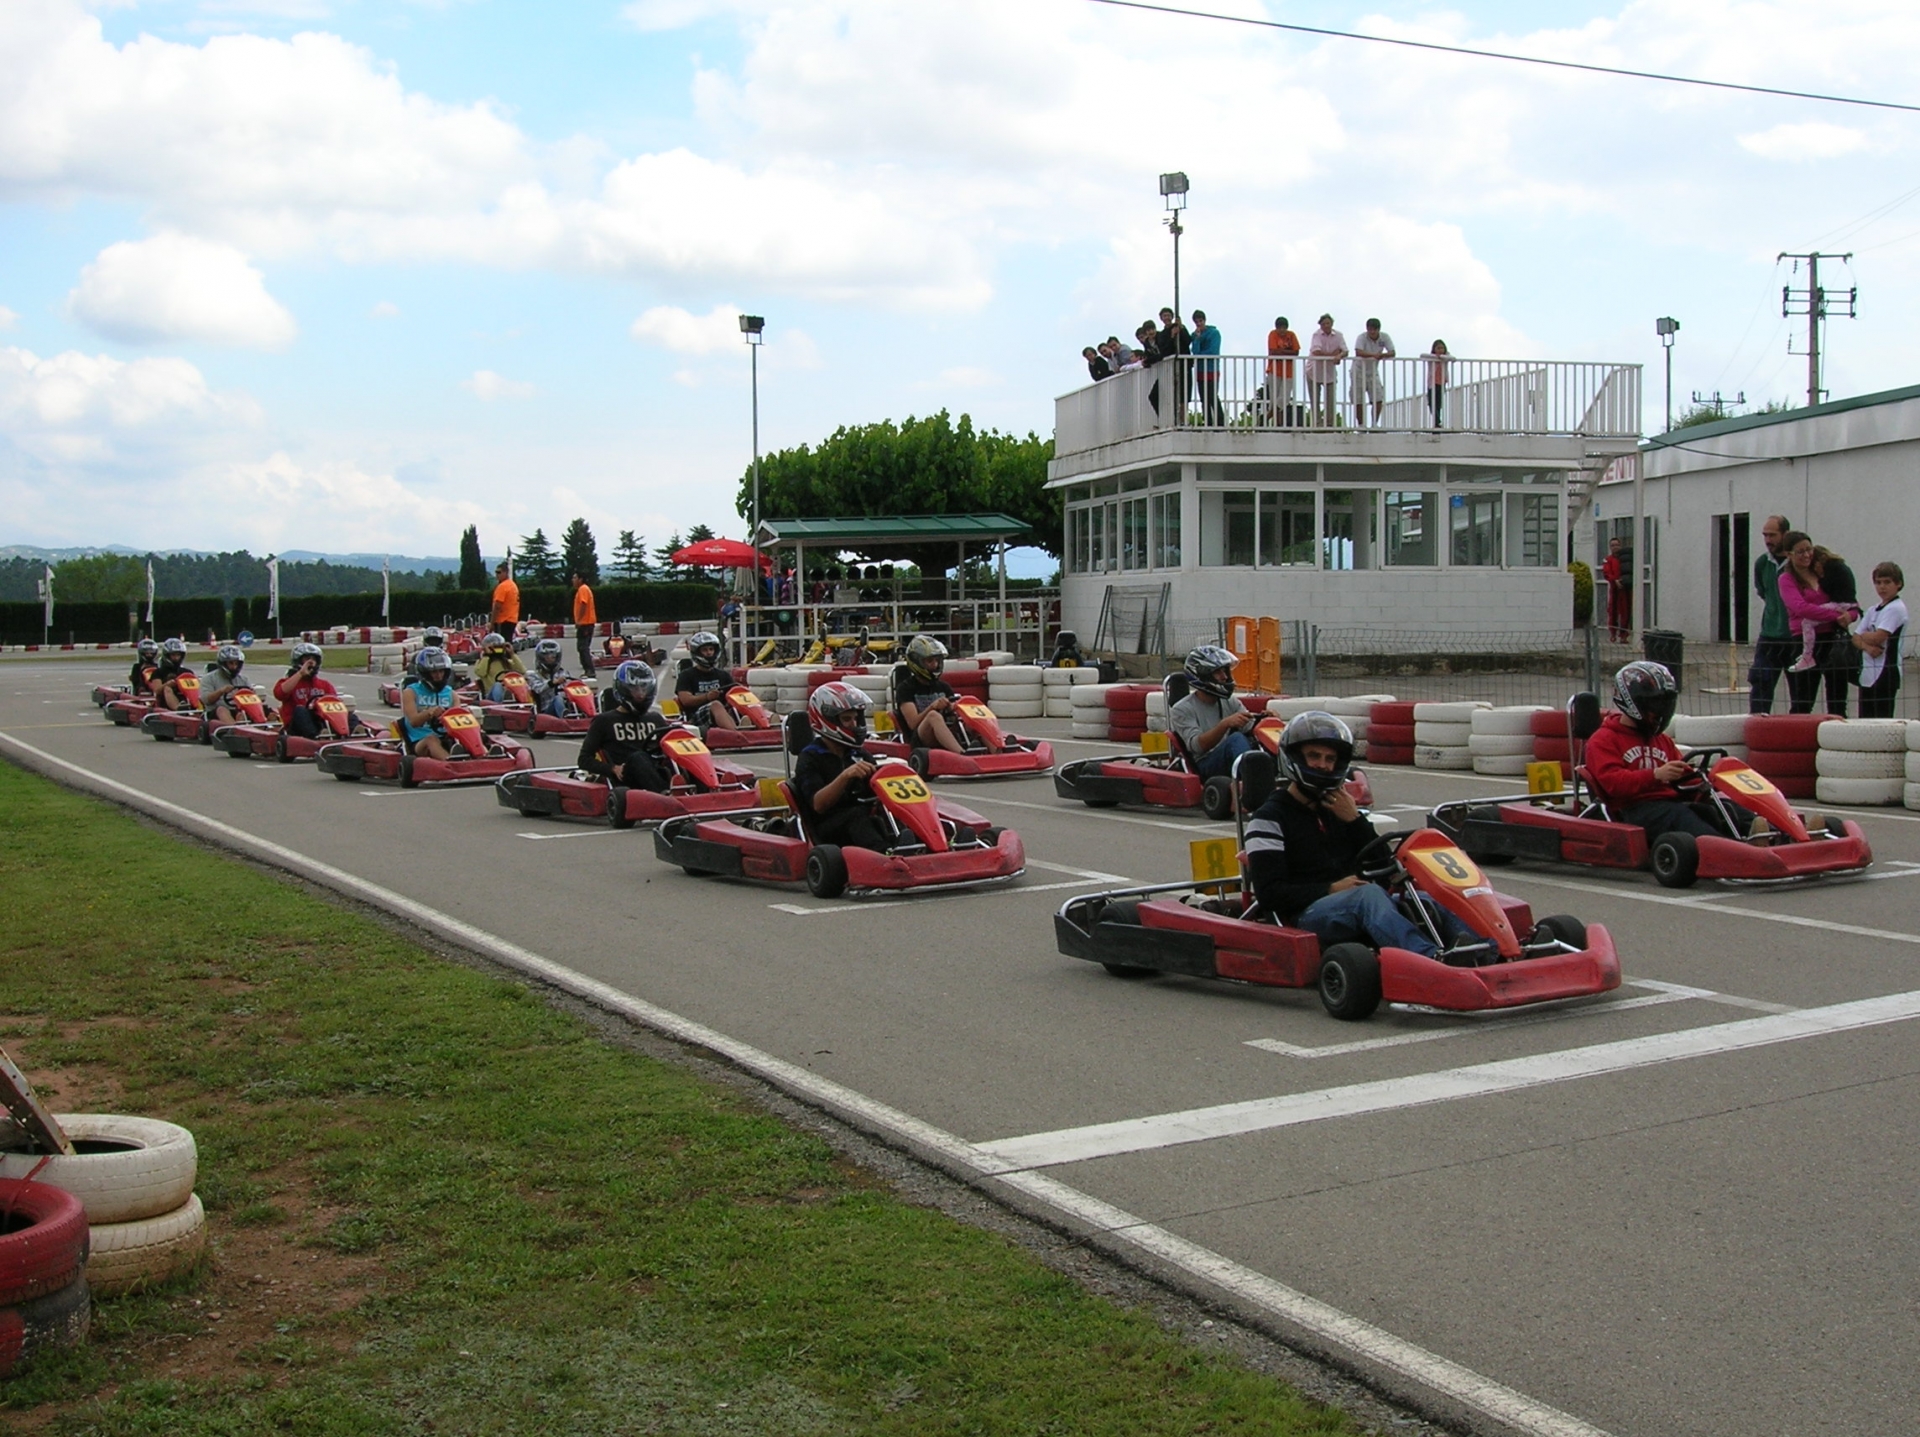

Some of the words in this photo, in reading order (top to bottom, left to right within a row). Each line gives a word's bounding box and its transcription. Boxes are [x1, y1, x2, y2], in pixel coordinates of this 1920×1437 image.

[738, 693, 752, 703] 2
[323, 703, 343, 712] 20
[970, 705, 986, 717] 3
[450, 715, 473, 727] 13
[677, 740, 700, 752] 11
[1735, 773, 1764, 791] 6
[886, 778, 928, 800] 33
[1206, 842, 1227, 879] 8
[1431, 851, 1469, 879] 8
